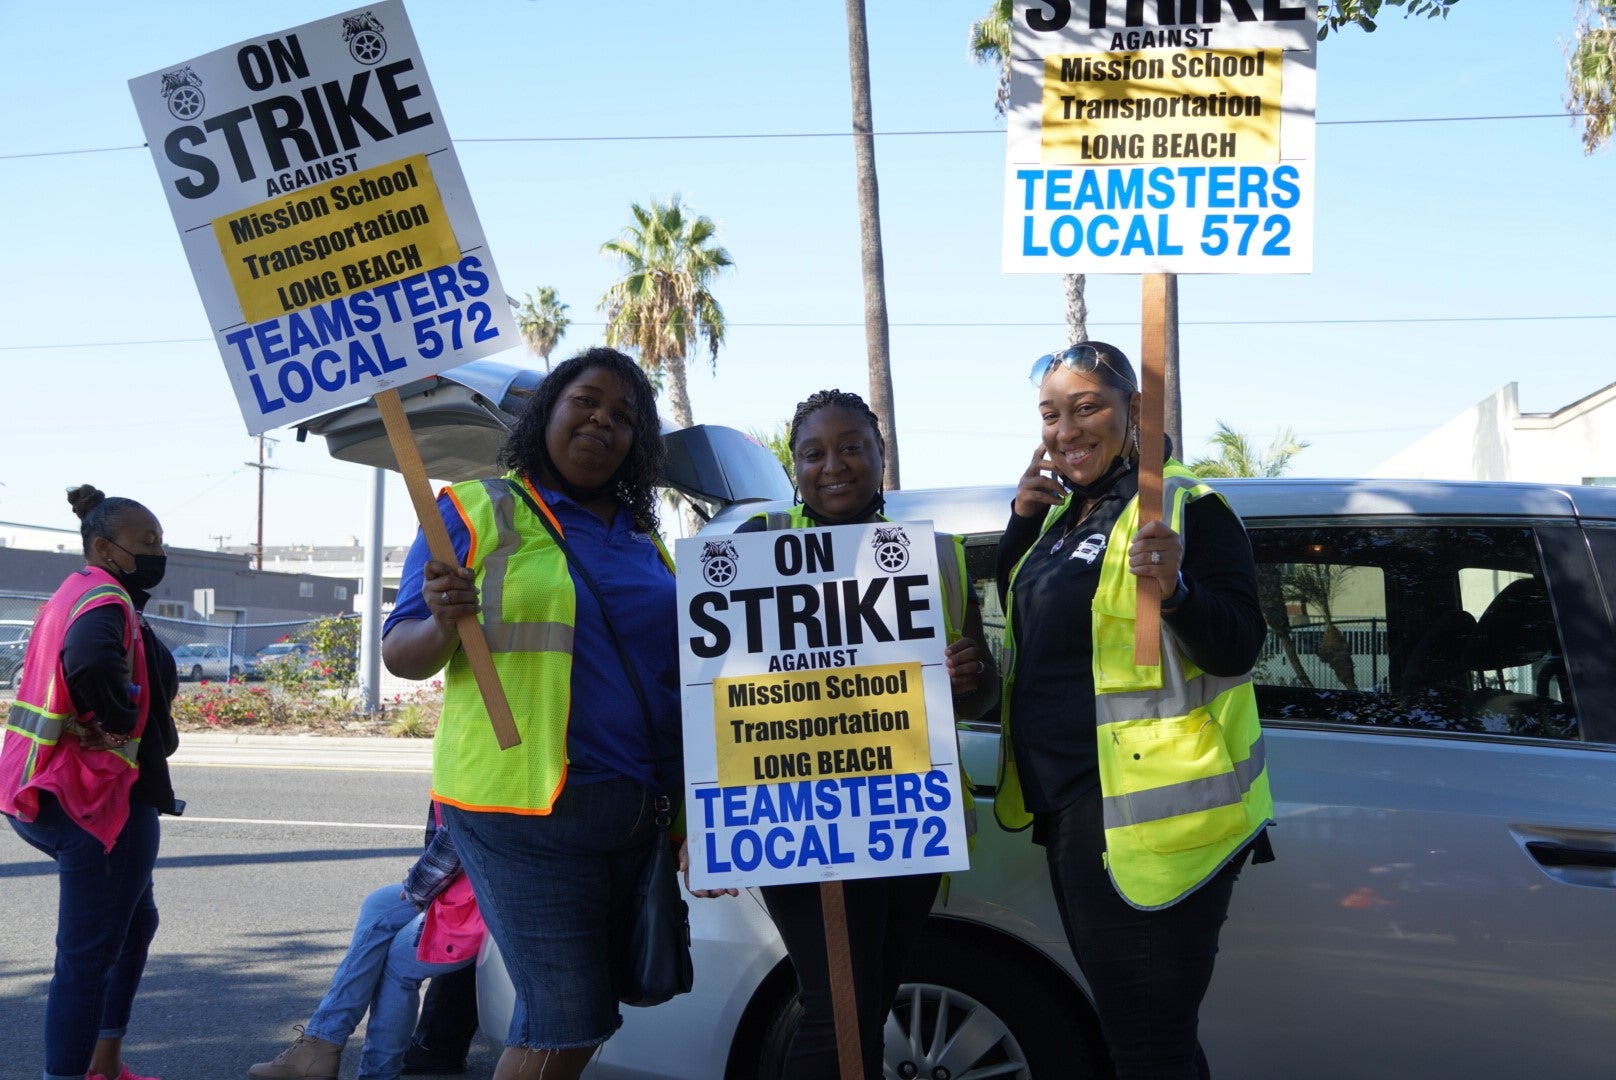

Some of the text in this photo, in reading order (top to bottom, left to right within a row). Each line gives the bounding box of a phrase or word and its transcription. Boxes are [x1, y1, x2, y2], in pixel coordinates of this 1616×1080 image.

[1110, 28, 1212, 50] AGAINST
[237, 34, 310, 91] ON
[1060, 51, 1264, 82] Mission School
[1061, 92, 1261, 119] Transportation
[164, 58, 434, 199] STRIKE
[1081, 133, 1235, 159] LONG BEACH
[267, 153, 358, 197] AGAINST
[1017, 165, 1300, 210] TEAMSTERS
[229, 164, 418, 245] Mission School
[242, 204, 429, 279] Transportation
[1023, 214, 1290, 256] LOCAL 572
[277, 244, 422, 311] LONG BEACH
[225, 256, 489, 371] TEAMSTERS
[249, 301, 499, 414] LOCAL 572
[775, 532, 834, 576] ON
[689, 575, 935, 658] STRIKE
[769, 649, 857, 672] AGAINST
[729, 670, 907, 707] Mission School
[731, 709, 909, 743] Transportation
[754, 746, 892, 780] LONG BEACH
[695, 770, 951, 828] TEAMSTERS
[706, 816, 949, 873] LOCAL 572
